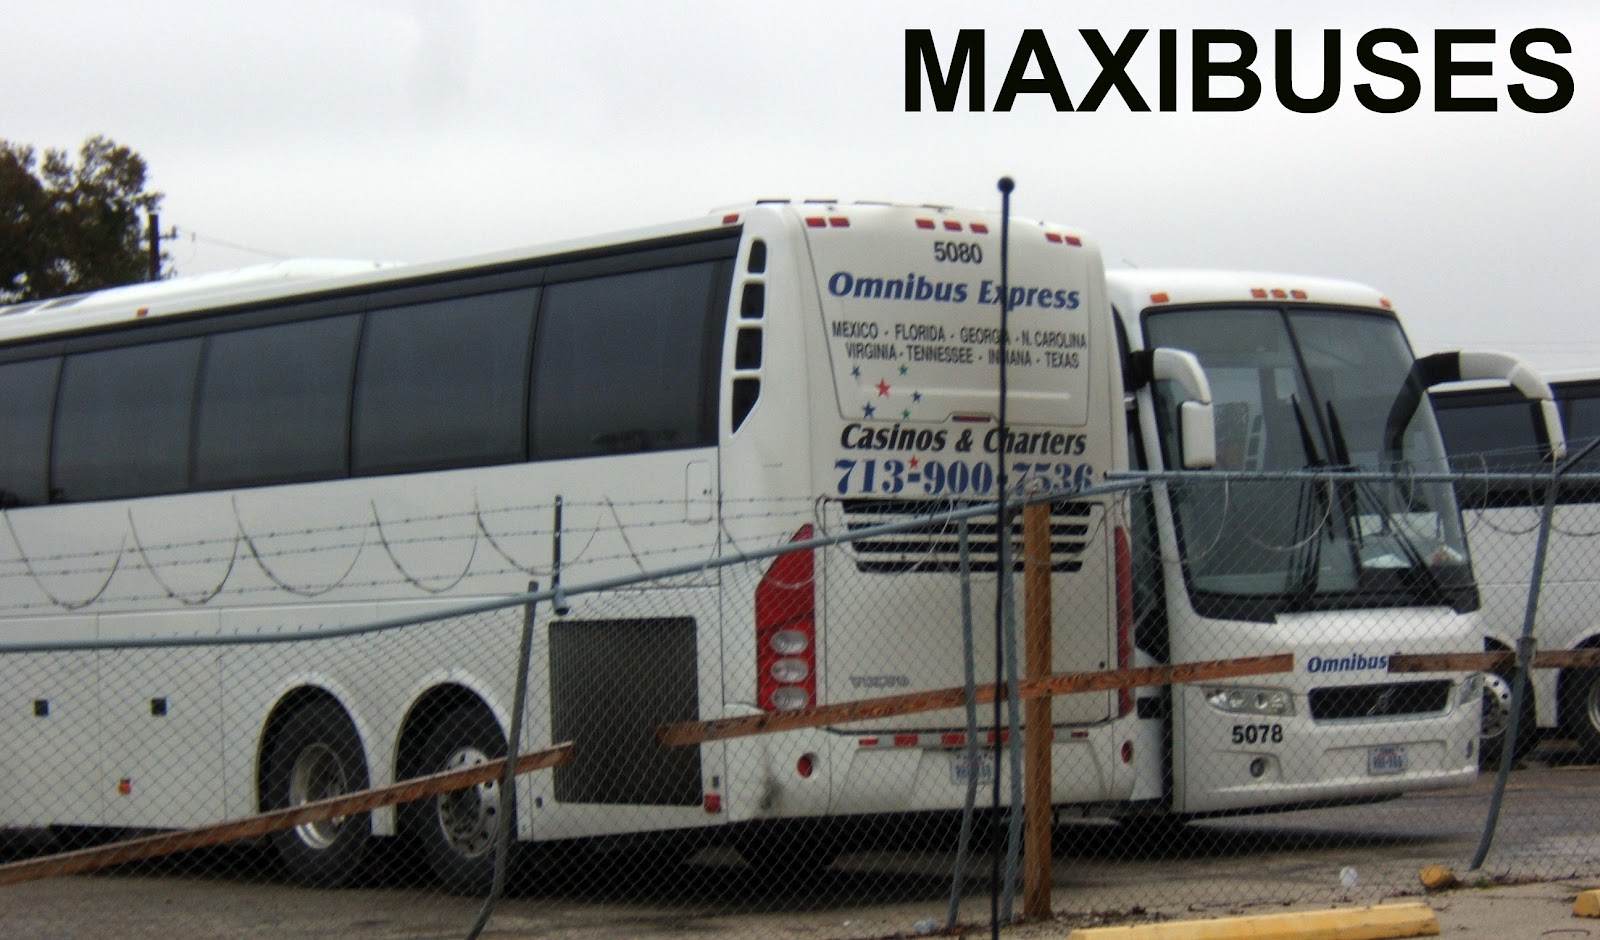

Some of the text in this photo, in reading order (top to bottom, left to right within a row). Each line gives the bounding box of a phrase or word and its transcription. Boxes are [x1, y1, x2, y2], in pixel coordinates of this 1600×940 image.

[934, 241, 983, 264] 5080
[828, 271, 1080, 312] Omnibus Express
[832, 320, 878, 339] MEXICO
[895, 323, 945, 342] FLORIDA
[960, 326, 1011, 346] GEORGA
[1034, 330, 1087, 350] CAROLINA
[845, 341, 897, 360] VIRGINIA
[906, 344, 974, 364] TENNESSEE
[988, 347, 1032, 367] INIANA
[1044, 350, 1080, 370] TEXAS
[841, 423, 1087, 455] Casinos & Charters
[1307, 653, 1387, 673] Omnibus
[1232, 724, 1284, 745] 5078
